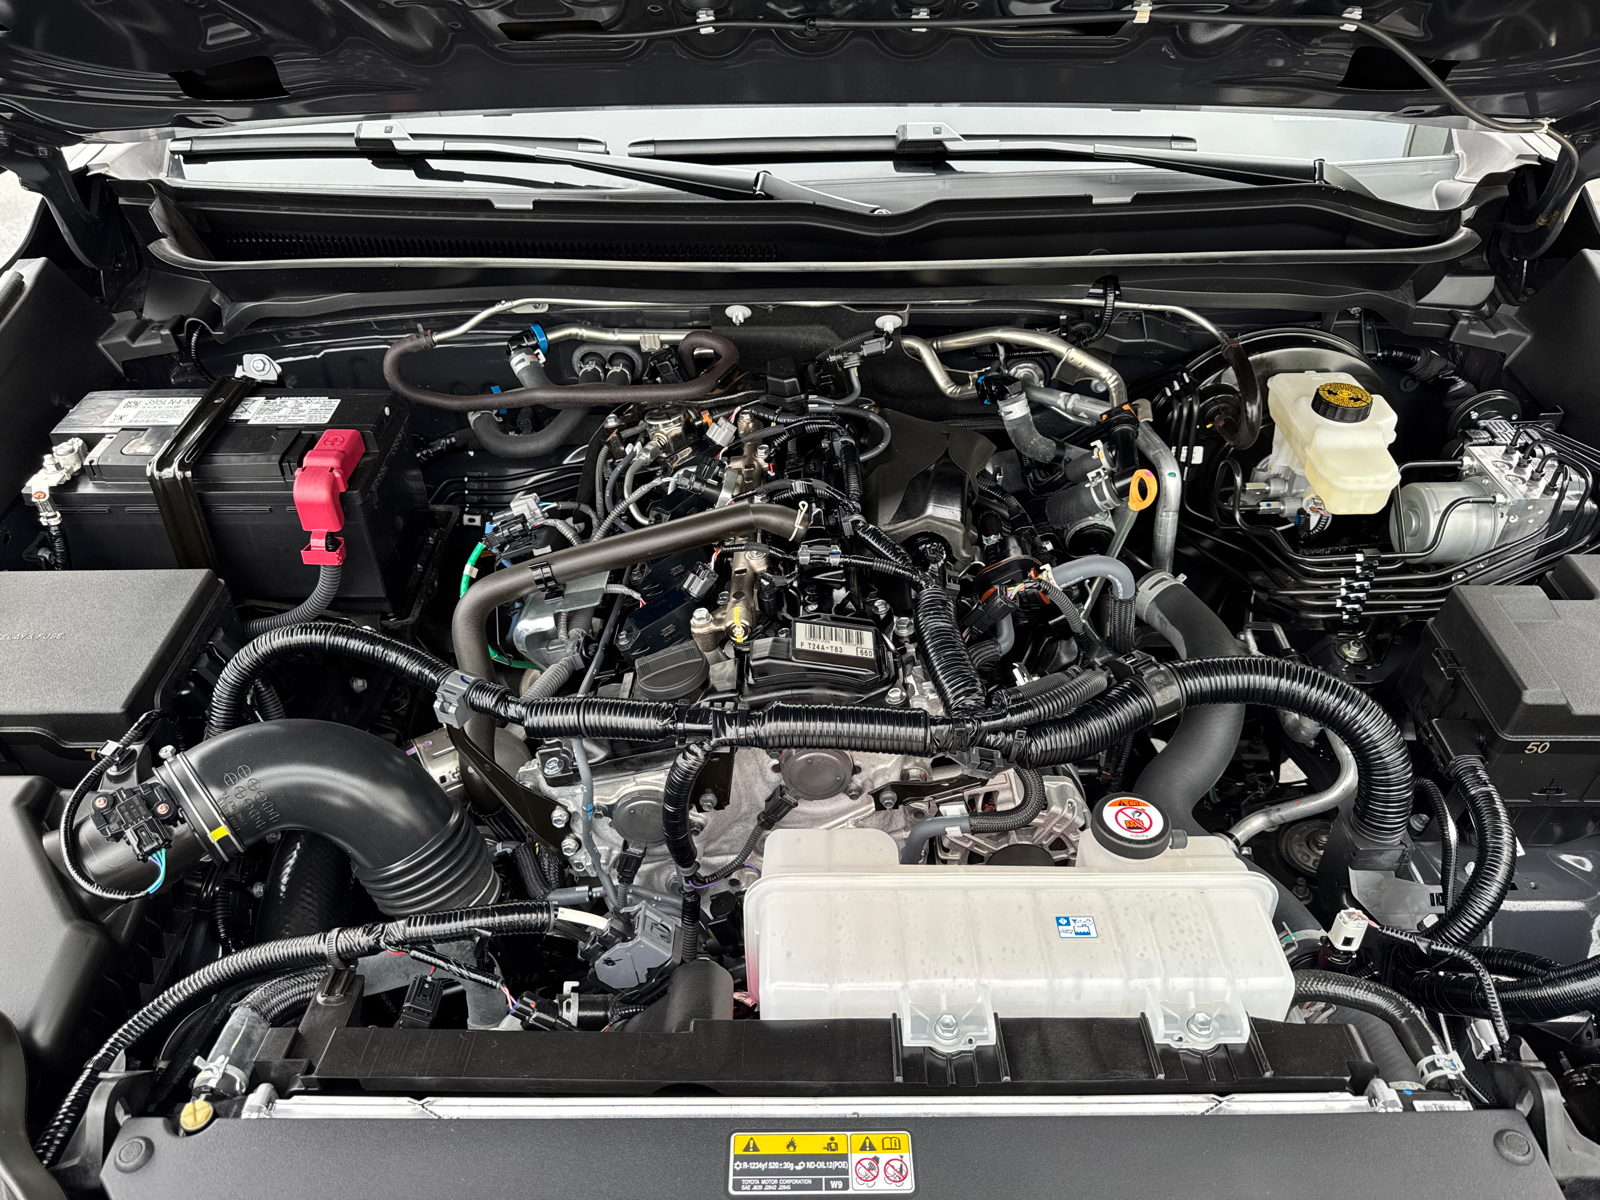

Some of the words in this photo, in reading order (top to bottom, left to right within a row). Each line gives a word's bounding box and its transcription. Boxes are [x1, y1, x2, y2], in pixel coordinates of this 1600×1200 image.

[36, 632, 66, 641] FUSE
[1524, 741, 1551, 754] 50
[84, 748, 97, 761] 7
[742, 1161, 768, 1171] R-1234yf
[829, 1180, 843, 1189] W9
